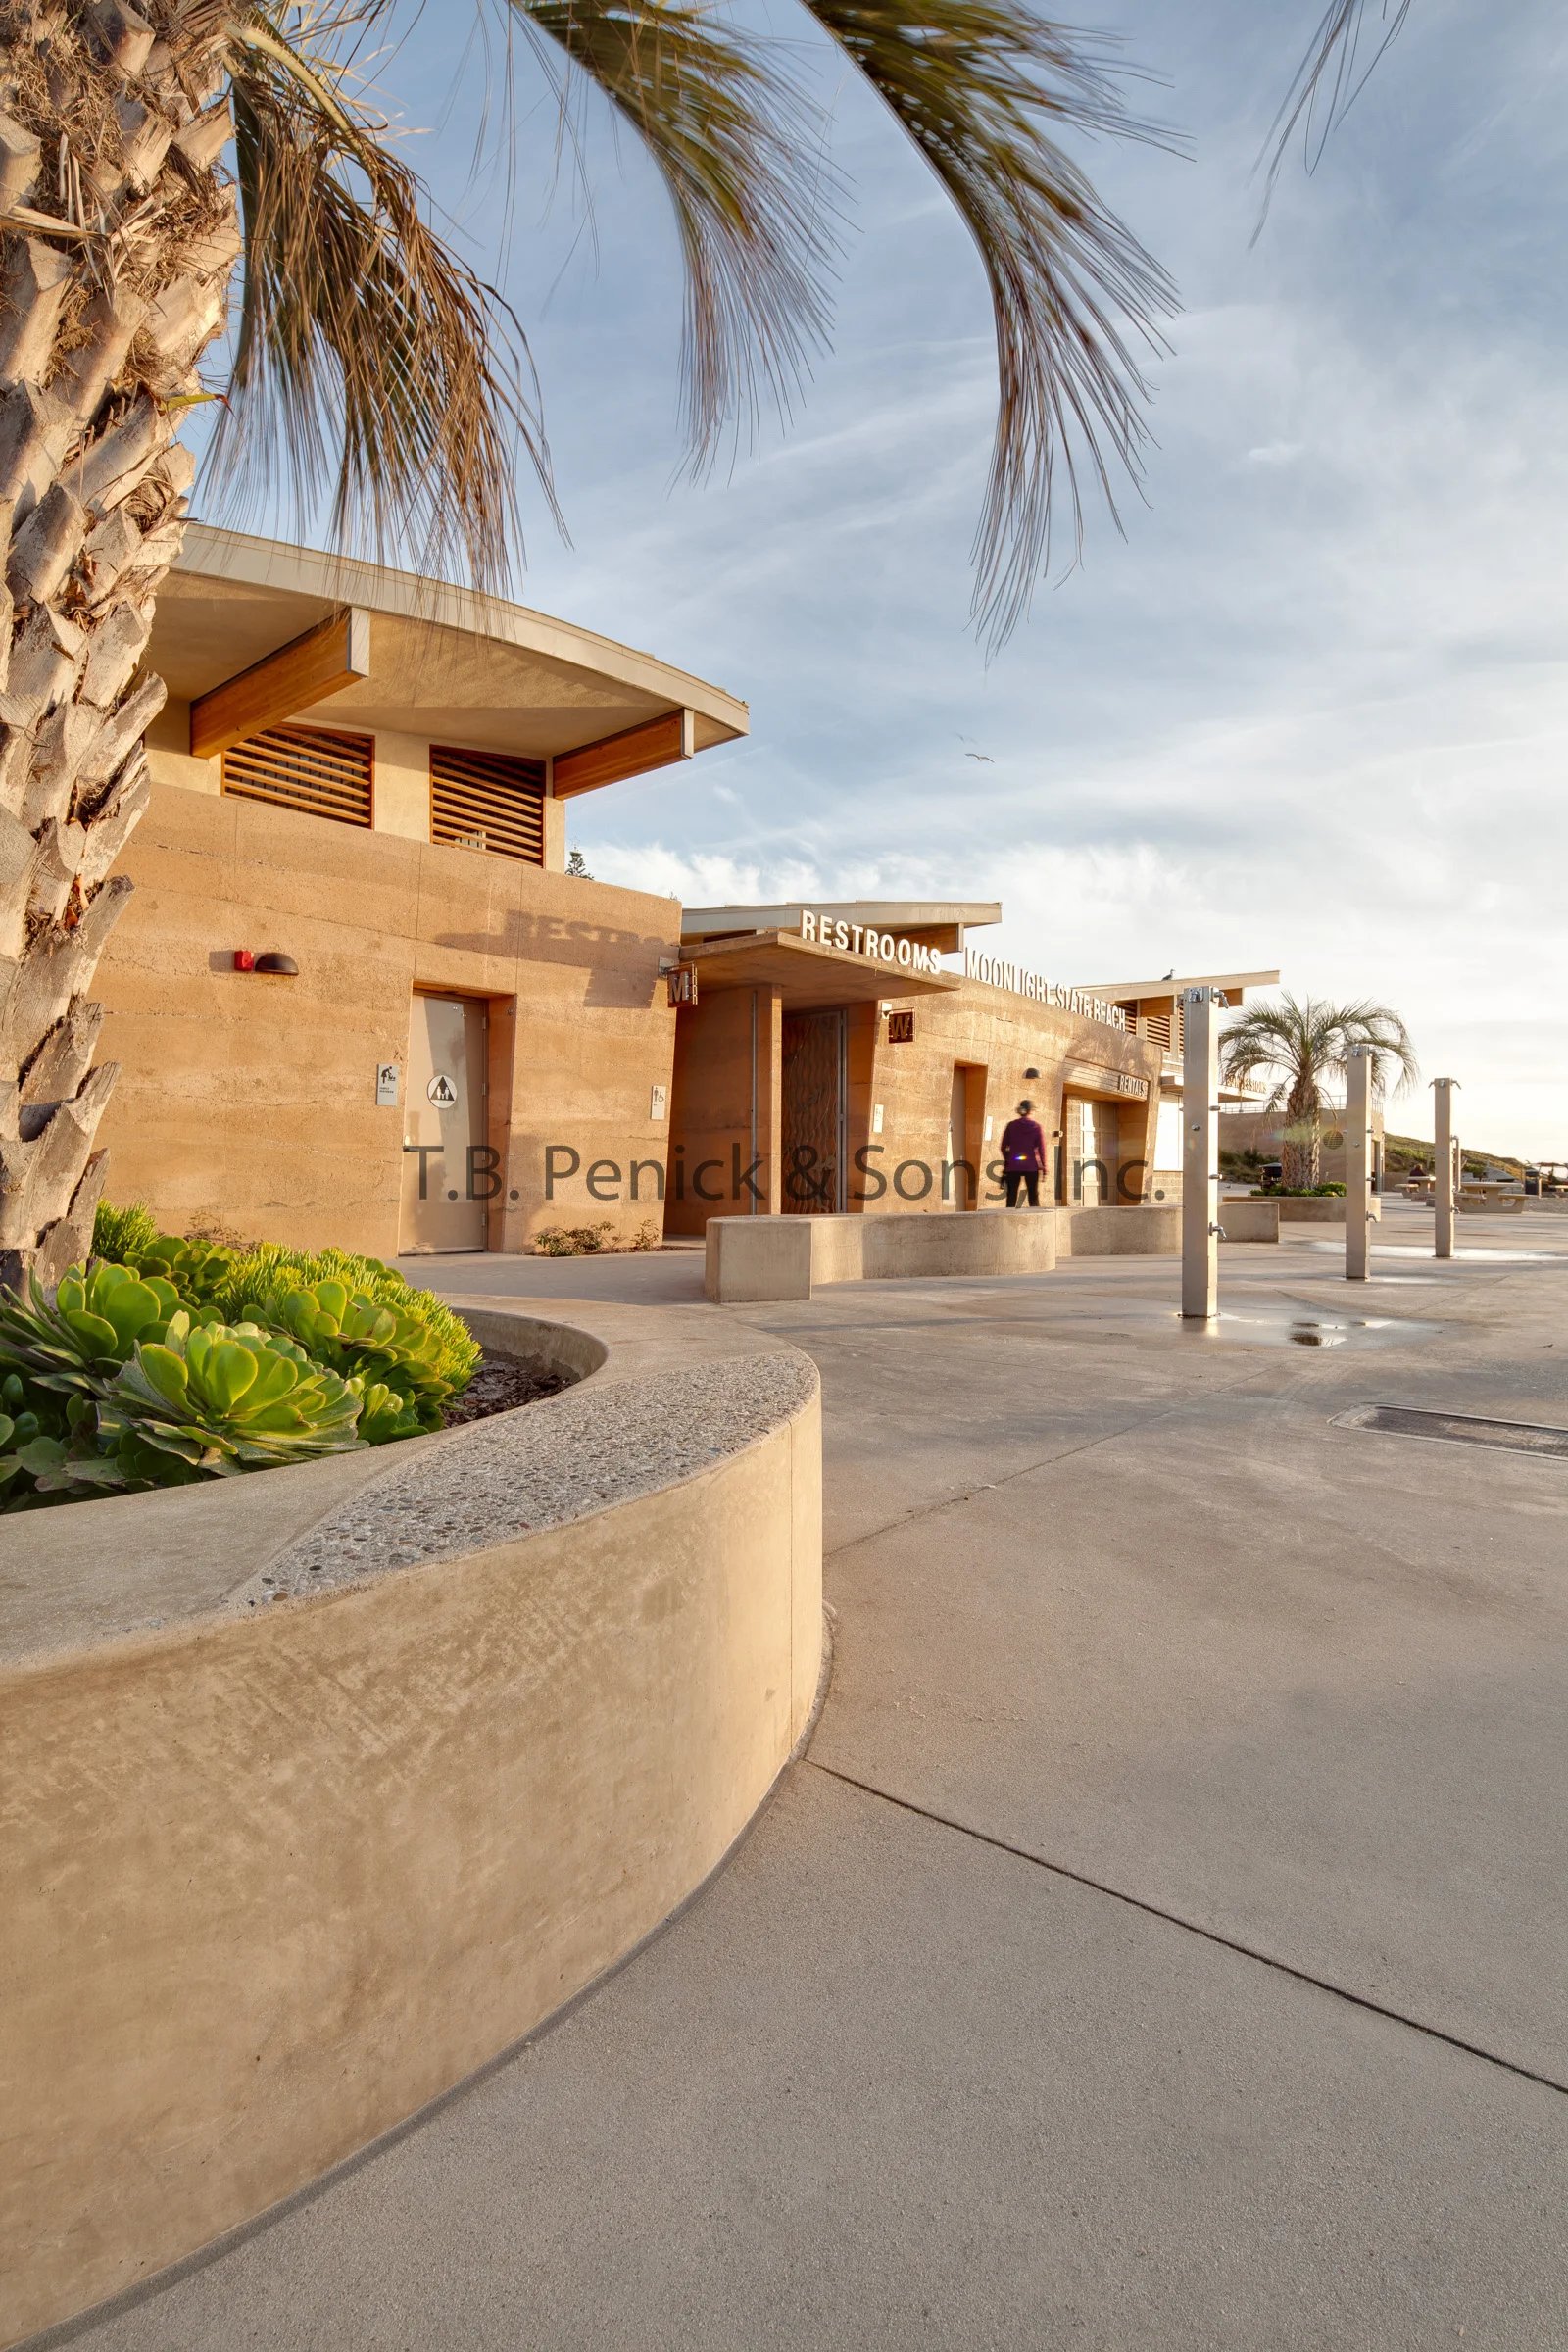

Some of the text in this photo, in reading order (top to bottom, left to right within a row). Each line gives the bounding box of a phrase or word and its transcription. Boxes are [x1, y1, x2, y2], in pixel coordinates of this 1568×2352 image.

[801, 909, 942, 975] RESTROOMS
[668, 970, 690, 1003] M
[965, 947, 1126, 1032] MOONLIGHT STATE BEACH
[889, 1014, 911, 1040] W
[1118, 1074, 1145, 1097] RENTALS
